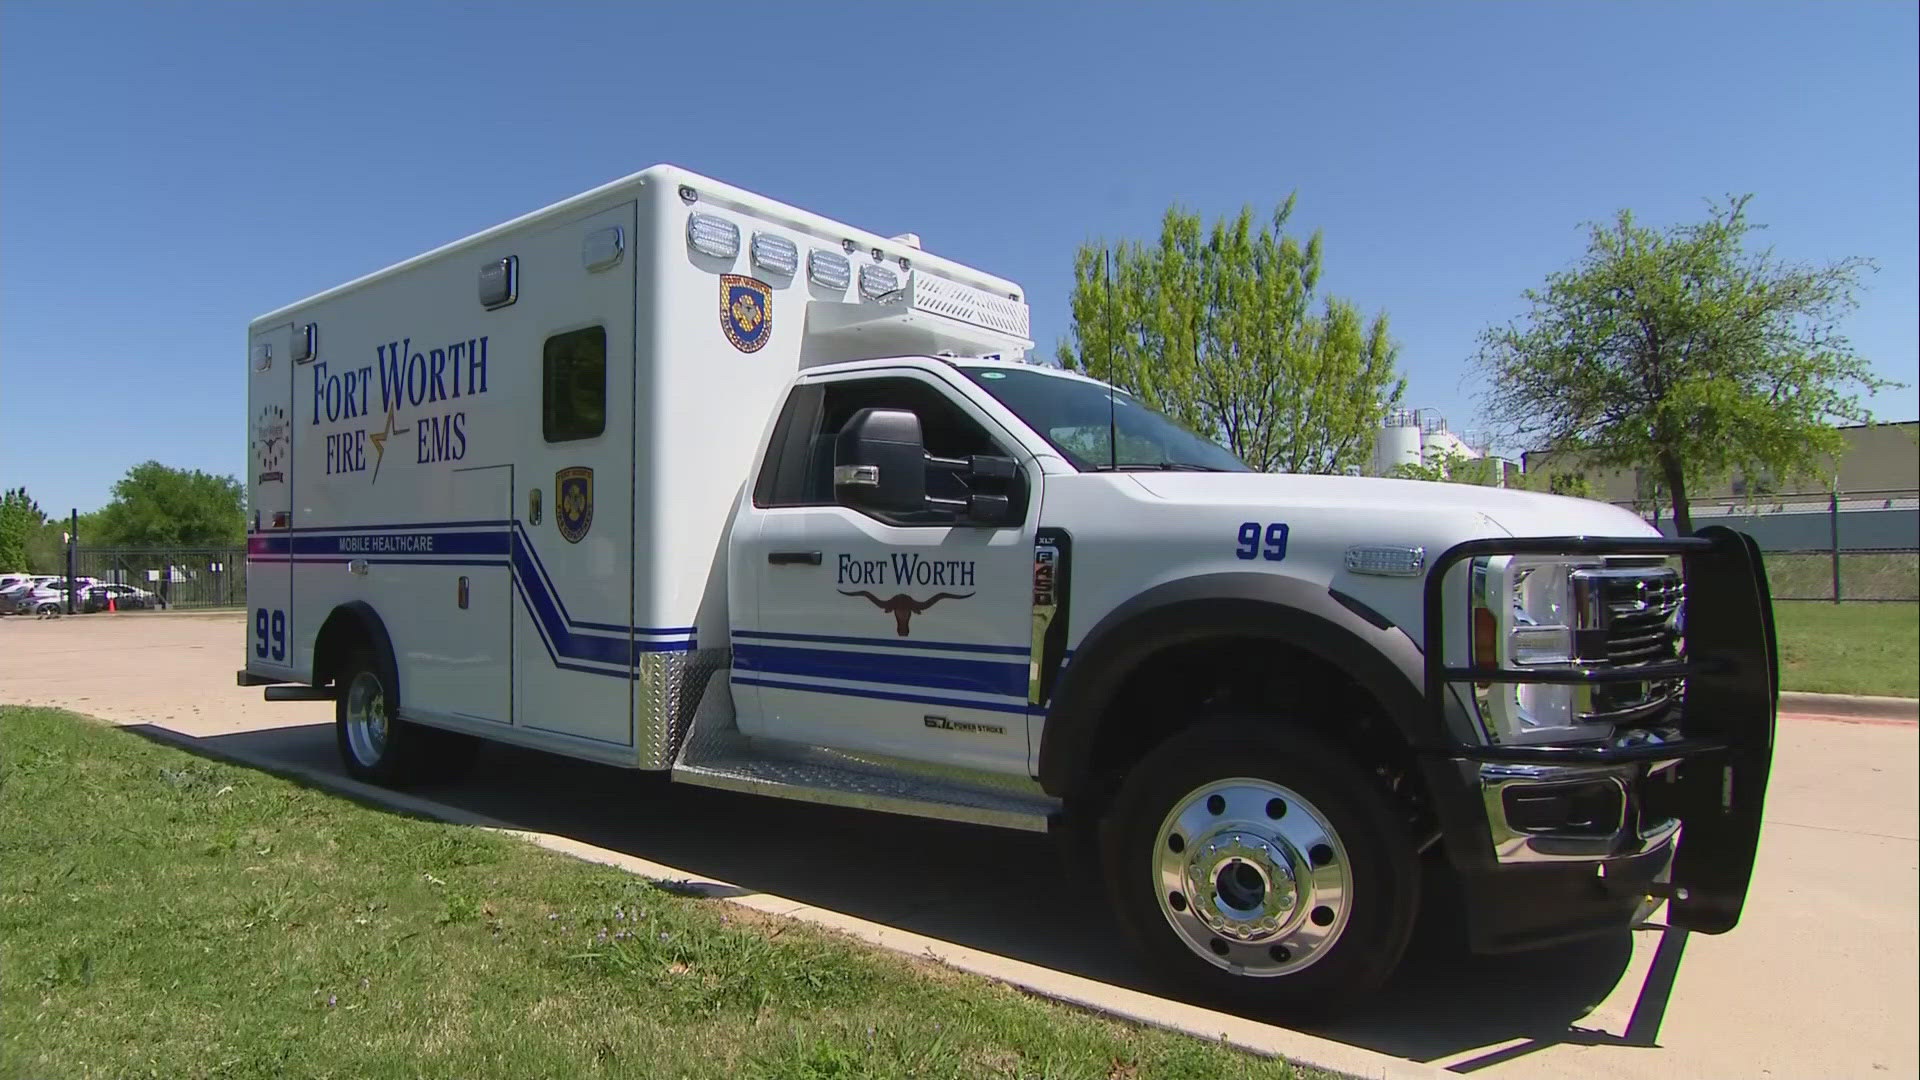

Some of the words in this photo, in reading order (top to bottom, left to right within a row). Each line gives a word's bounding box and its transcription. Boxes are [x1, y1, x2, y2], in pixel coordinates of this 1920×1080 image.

[312, 361, 372, 425] FORT
[376, 336, 488, 413] WORTH
[326, 430, 366, 475] FIRE
[417, 412, 466, 464] EMS
[339, 536, 370, 552] MOBILE
[372, 535, 433, 552] HEALTHCARE
[1236, 522, 1290, 561] 99
[837, 553, 888, 585] FORT
[890, 553, 975, 586] WORTH
[256, 607, 286, 661] 99
[923, 715, 953, 730] 6.7L
